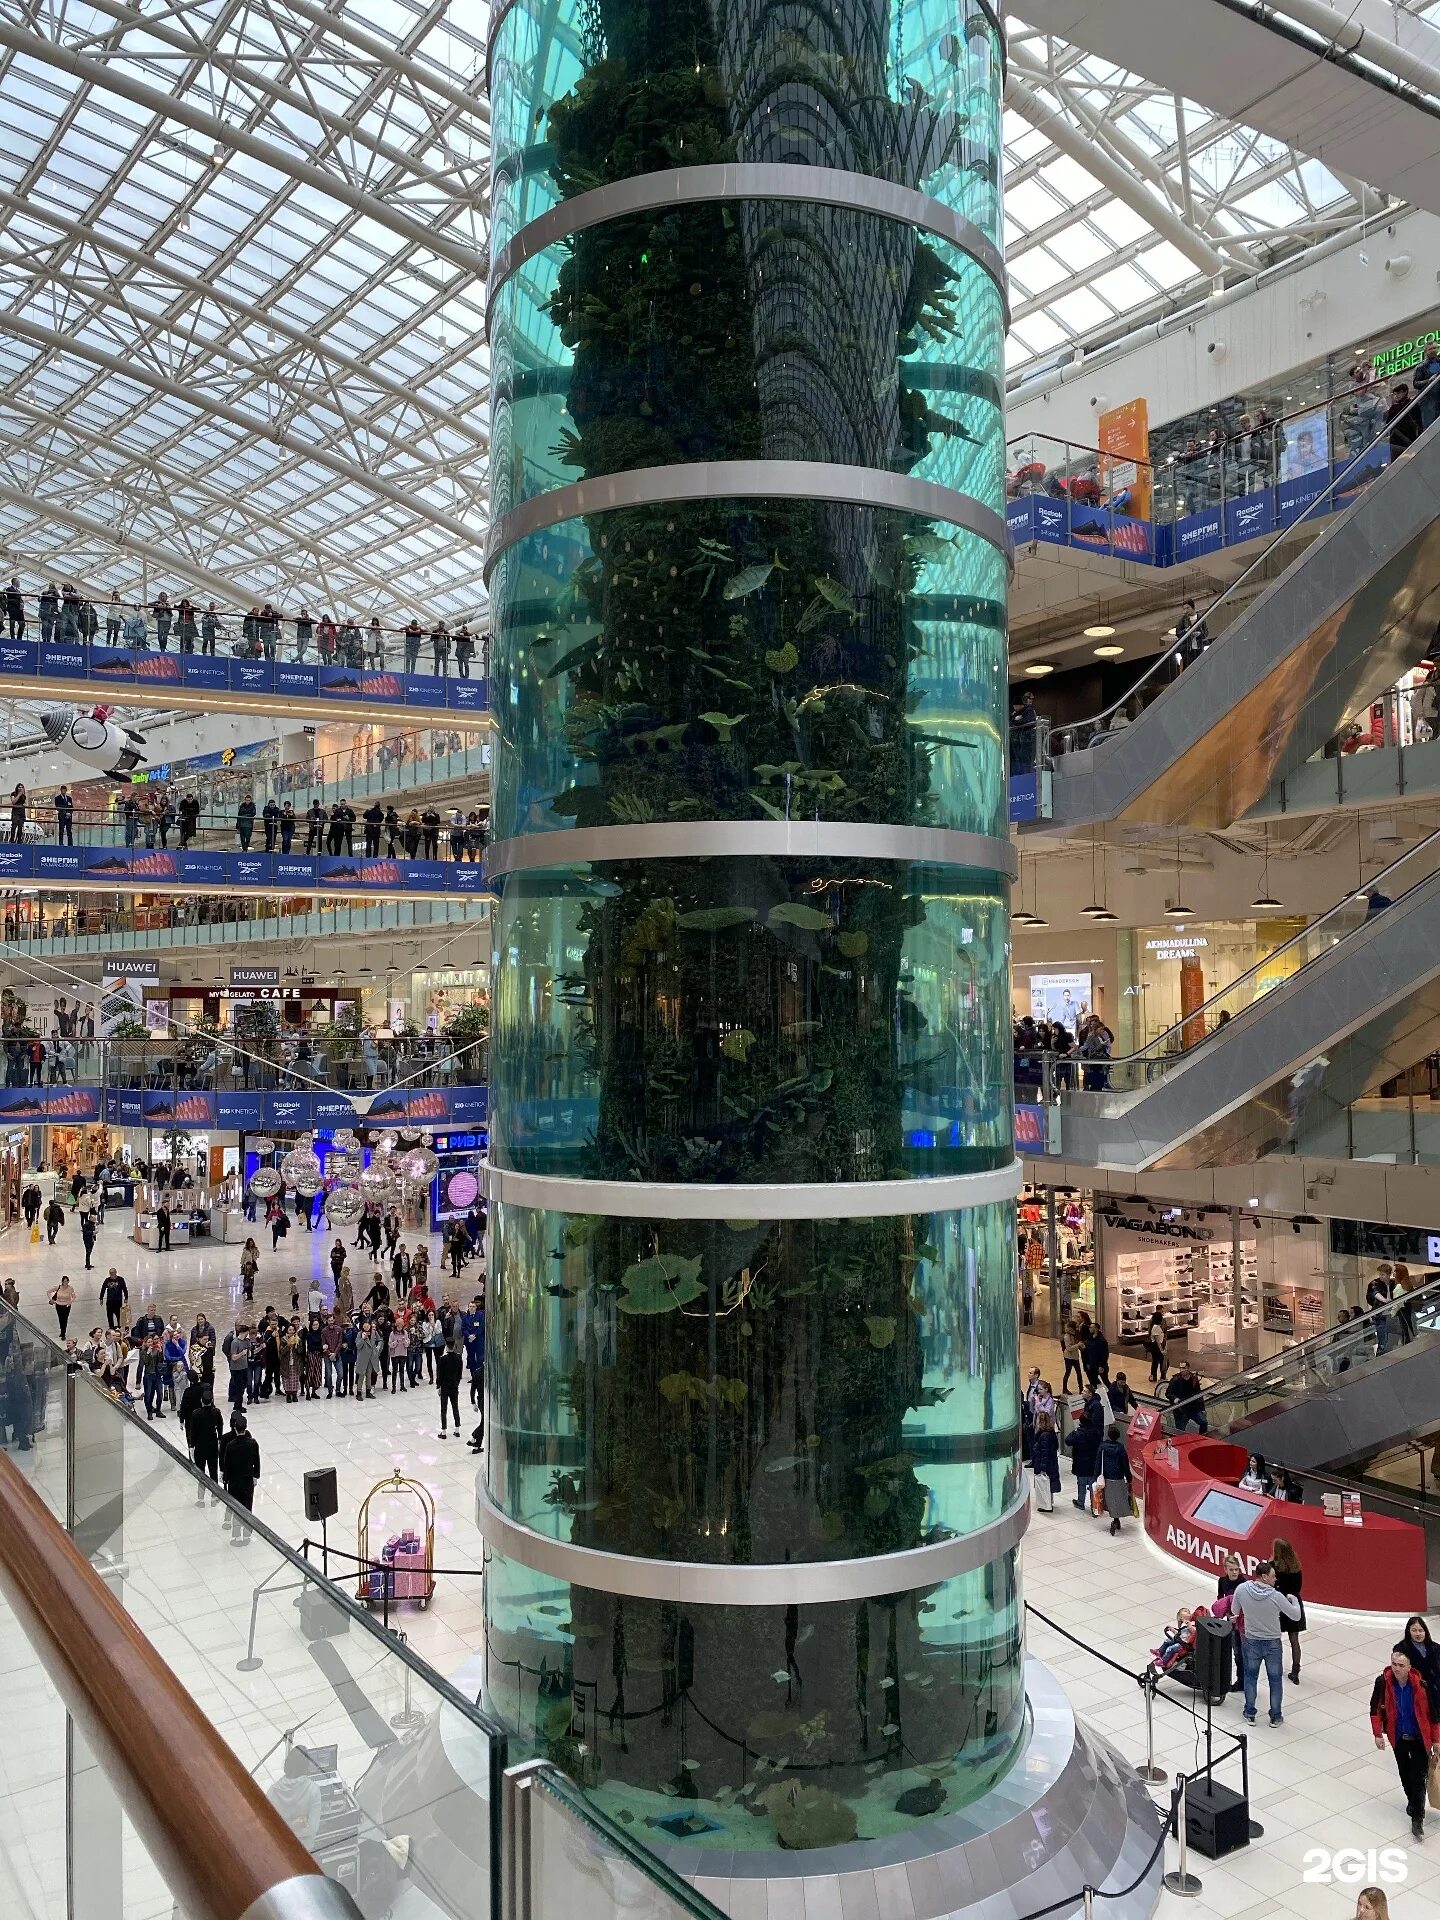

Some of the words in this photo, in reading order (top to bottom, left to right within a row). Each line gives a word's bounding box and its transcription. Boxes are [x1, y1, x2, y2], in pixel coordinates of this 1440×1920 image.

[1295, 489, 1322, 505] KINETIC
[1038, 507, 1063, 519] Reebok
[1236, 502, 1264, 518] Reebok
[1181, 521, 1218, 541] ЭНЕРГИЯ
[0, 647, 28, 655] Reebok
[45, 653, 83, 662] ЭНЕРГИЯ
[280, 673, 314, 682] ЭНЕРГИЯ
[278, 865, 312, 873] ЭНЕРГИЯ
[1145, 937, 1208, 949] AKHMADULLINA
[1156, 948, 1196, 960] DREAMS
[107, 961, 156, 973] HUAWEI
[233, 971, 277, 980] HUAWEI
[260, 988, 301, 998] CAFE
[450, 1135, 475, 1148] РИВ
[1104, 1214, 1214, 1242] VAGABOND
[1138, 1236, 1180, 1248] SHOEMAKERS
[1166, 1524, 1268, 1577] АВИАПАР
